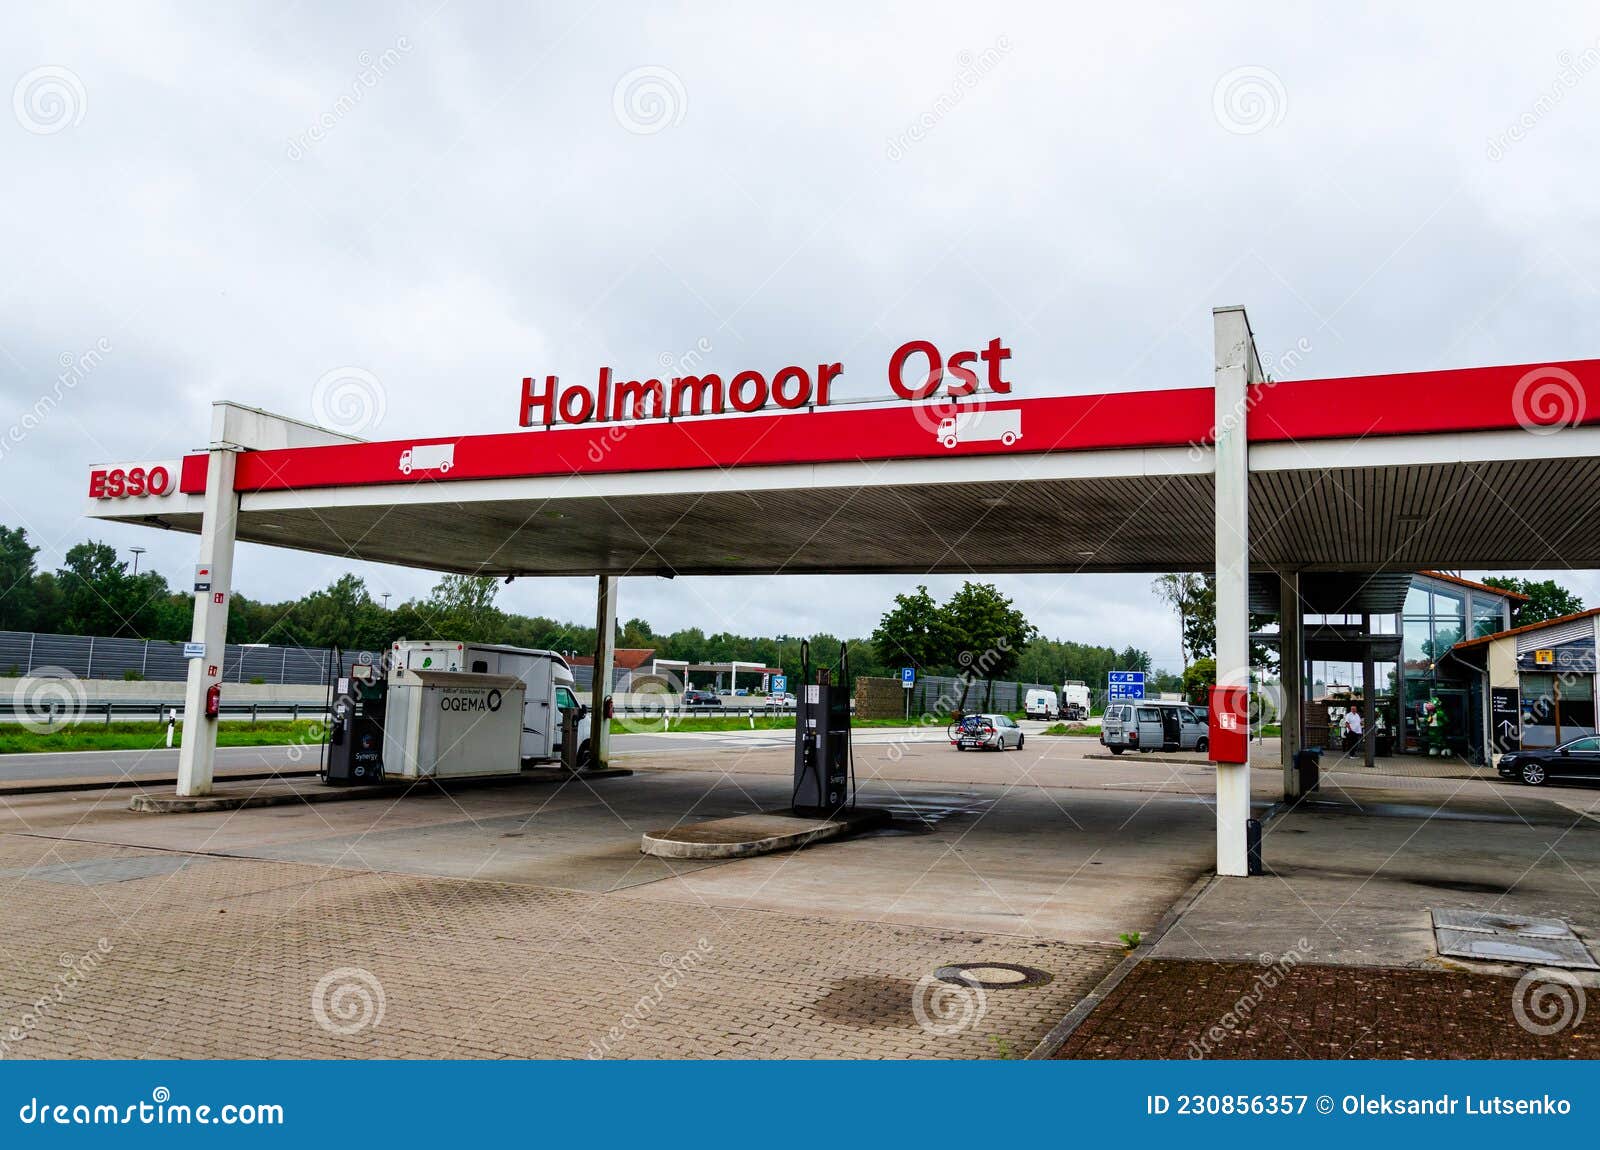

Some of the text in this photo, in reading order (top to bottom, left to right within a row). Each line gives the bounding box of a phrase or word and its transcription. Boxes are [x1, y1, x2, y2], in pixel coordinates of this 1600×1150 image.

[519, 338, 1012, 427] Holmmoor Ost
[89, 466, 170, 498] ESSO
[905, 670, 912, 680] P
[441, 697, 486, 711] OQEMA
